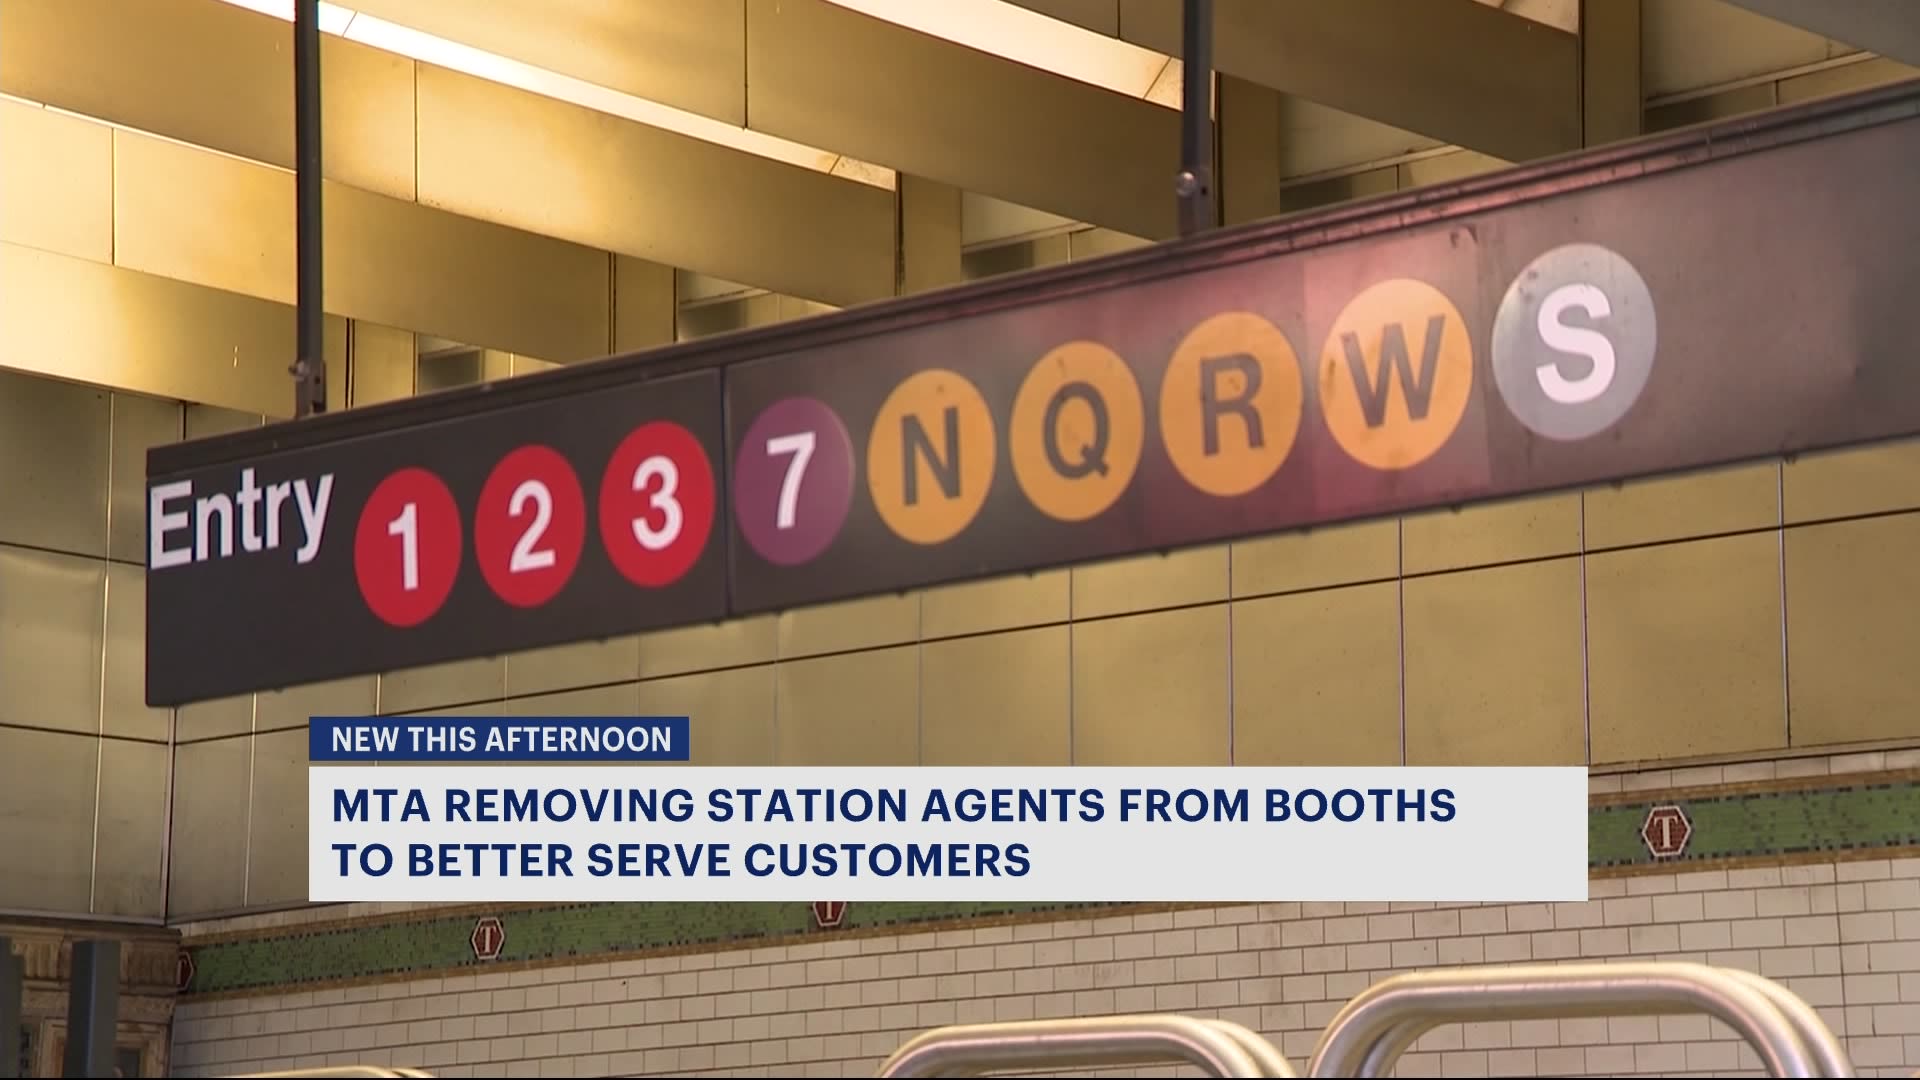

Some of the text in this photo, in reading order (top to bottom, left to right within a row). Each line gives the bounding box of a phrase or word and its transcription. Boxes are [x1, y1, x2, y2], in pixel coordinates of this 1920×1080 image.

[149, 283, 1617, 591] Entry 1 2 3 7 N Q R W S
[1653, 815, 1679, 850] T
